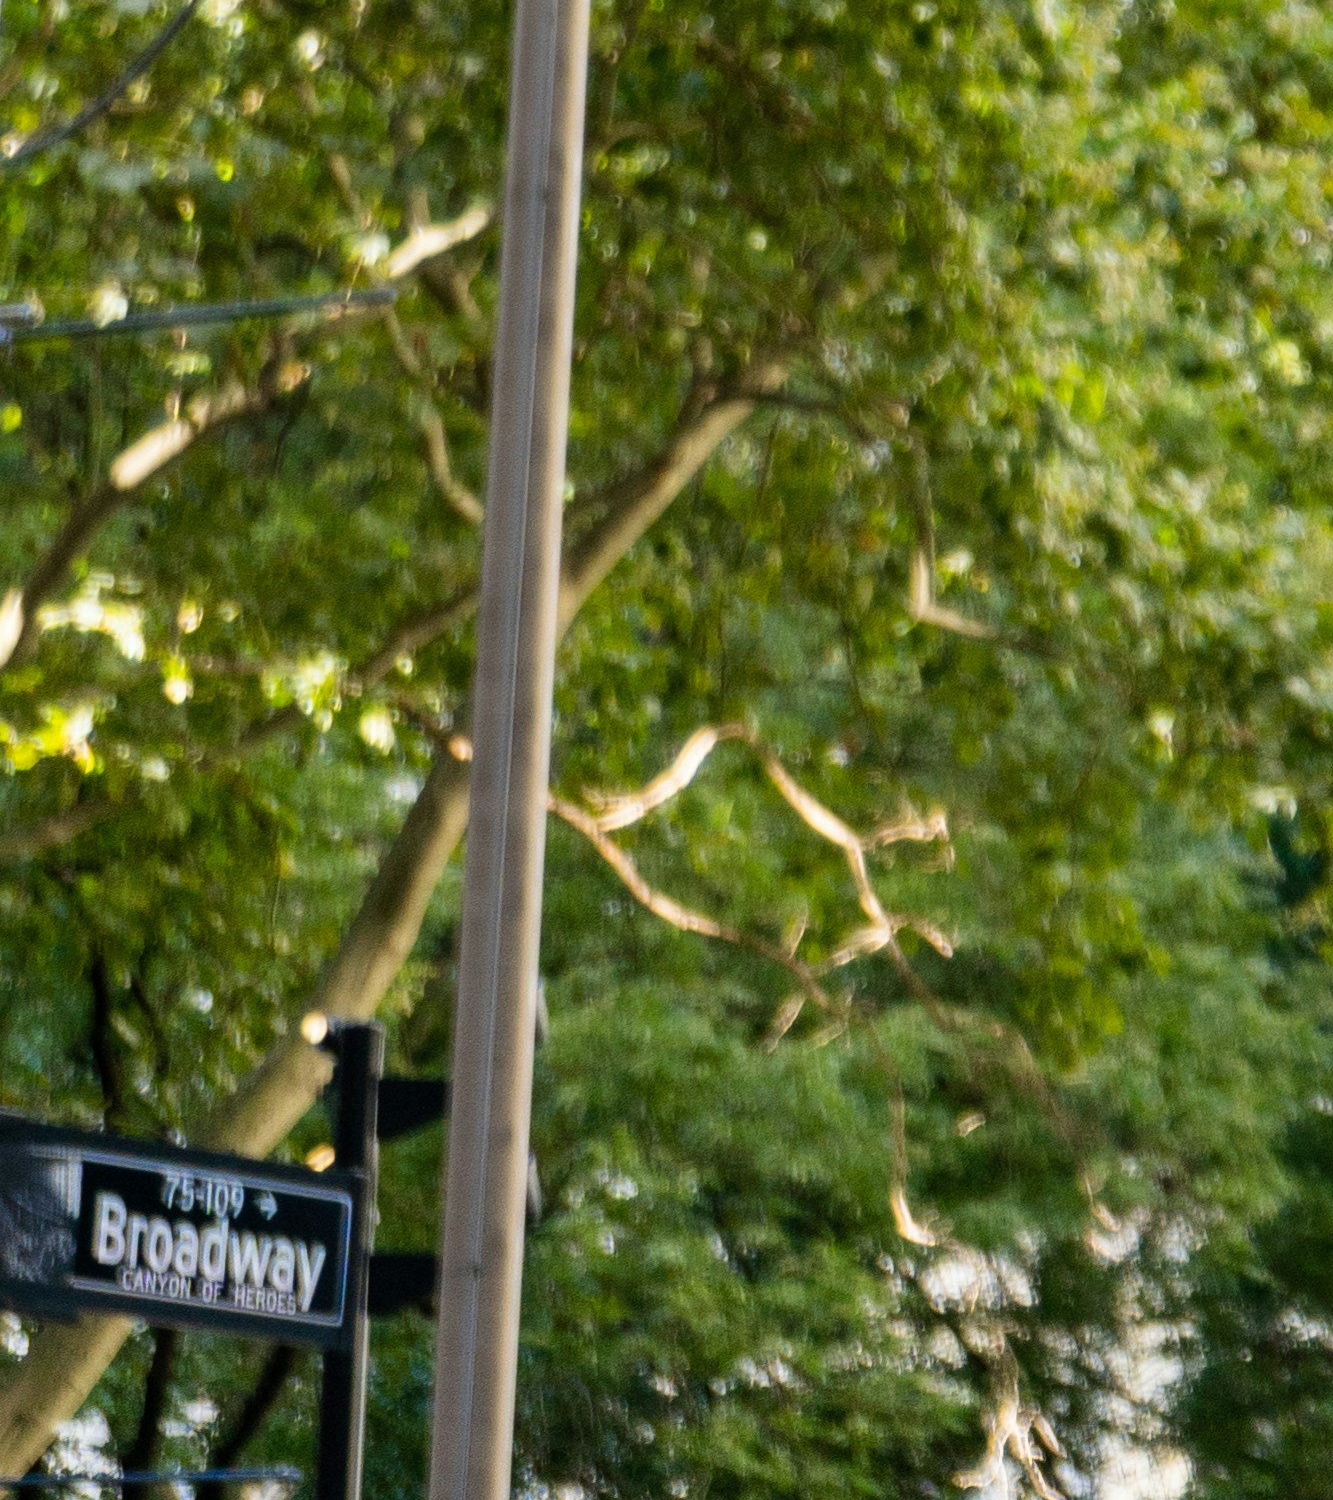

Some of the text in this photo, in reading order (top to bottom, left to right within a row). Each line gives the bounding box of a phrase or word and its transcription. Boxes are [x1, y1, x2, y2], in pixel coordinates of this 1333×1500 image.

[92, 1192, 327, 1313] Broadway
[120, 1269, 296, 1316] CANYON OF HEROES
